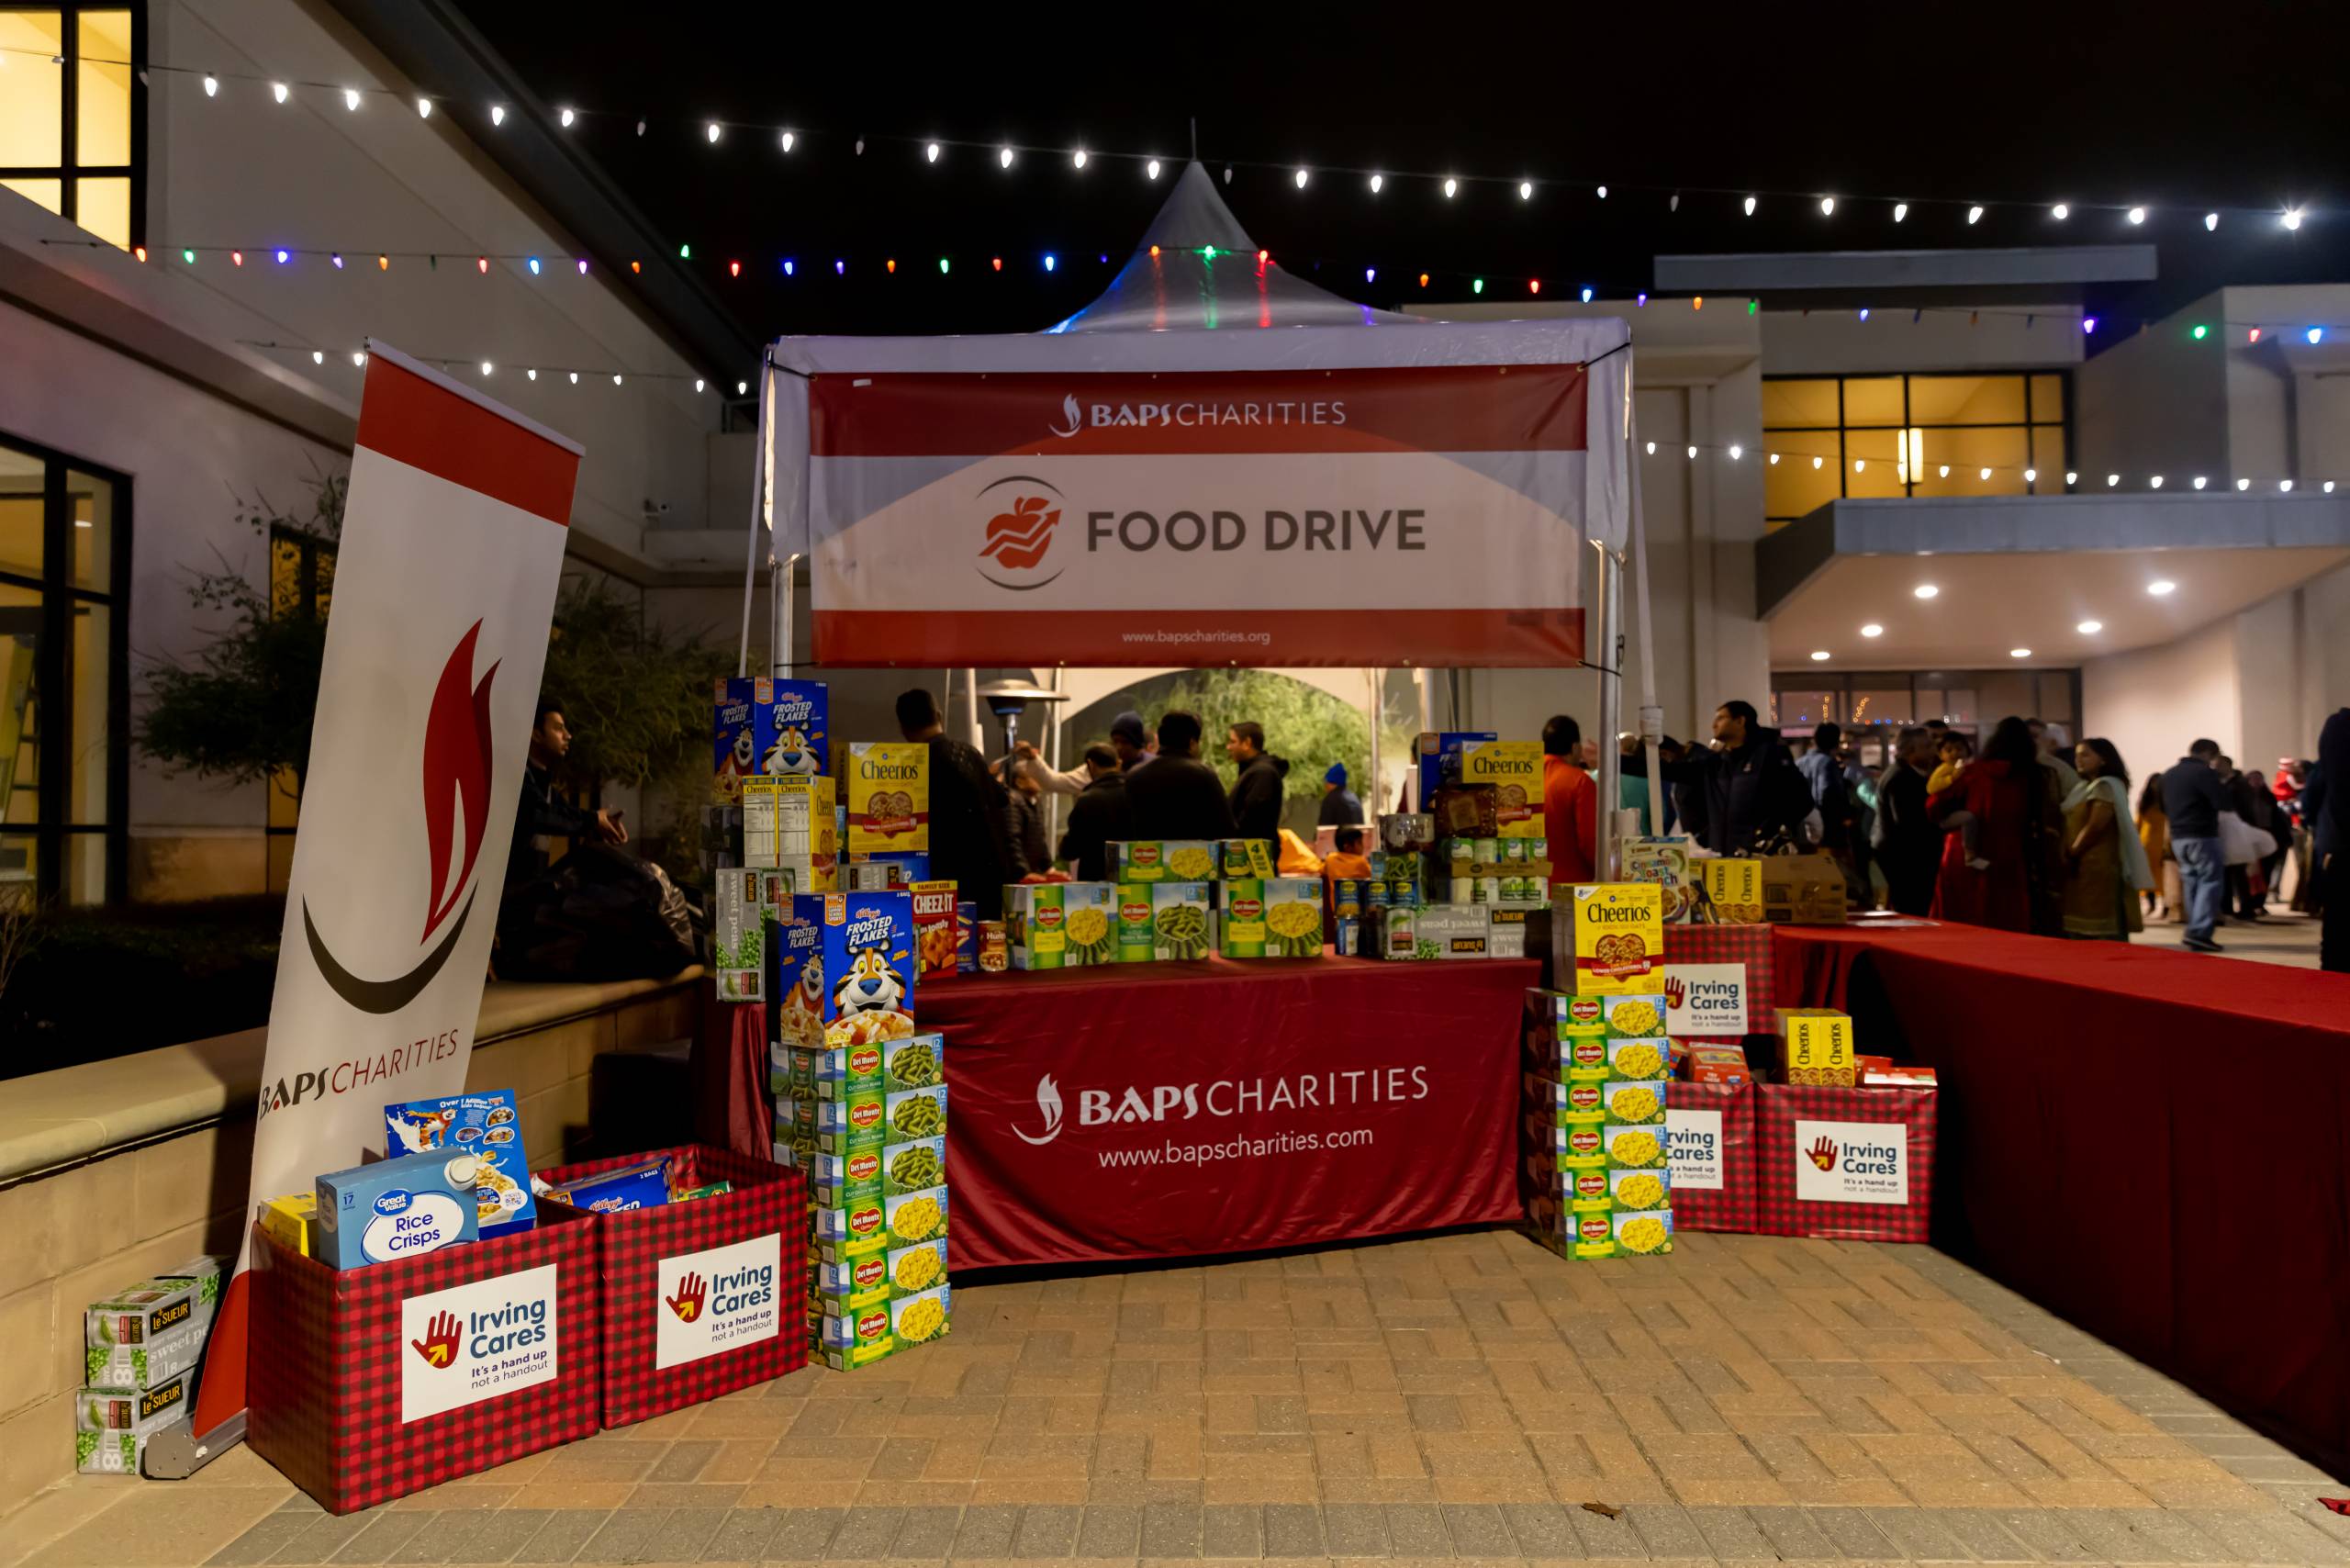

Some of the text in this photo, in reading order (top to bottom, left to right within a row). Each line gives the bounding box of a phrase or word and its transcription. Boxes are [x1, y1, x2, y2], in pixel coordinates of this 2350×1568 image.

[1087, 509, 1427, 553] FOOD DRIVE
[1121, 629, 1271, 645] www.bapscharities.org
[722, 703, 749, 717] FROSTED
[773, 700, 812, 715] FROSTED
[722, 712, 746, 725] FLAKES
[775, 711, 810, 723] FLAKES
[860, 759, 919, 780] Cheerios
[1472, 756, 1534, 774] Cheerios
[746, 785, 772, 793] Cheerios
[781, 785, 807, 793] Cheerios
[1714, 865, 1726, 902] Cheerios
[1740, 866, 1752, 902] Cheerios
[1587, 902, 1651, 924] Cheerios
[788, 925, 818, 940] FROSTED
[845, 915, 893, 936] FROSTED
[789, 935, 816, 949] FLAKES
[849, 927, 890, 946] FLAKES
[1689, 980, 1739, 998] Irving
[1690, 996, 1740, 1010] Cares
[933, 1038, 941, 1047] 12
[1798, 1023, 1811, 1065] Cheerios
[1830, 1023, 1842, 1065] Cheerios
[852, 1054, 878, 1067] Del Monte
[938, 1090, 946, 1098] 12
[440, 1100, 460, 1108] Over
[853, 1107, 880, 1119] Del Monte
[935, 1140, 944, 1148] 12
[1666, 1128, 1715, 1148] rving
[1098, 1126, 1374, 1169] www.bapscharities.com
[1842, 1142, 1897, 1163] Irving
[643, 1170, 658, 1178] BAGS
[850, 1160, 878, 1173] Del Monte
[1842, 1159, 1897, 1175] Cares
[343, 1194, 353, 1205] 17
[377, 1193, 407, 1207] Great
[938, 1190, 946, 1198] 12
[385, 1202, 408, 1212] Value
[588, 1196, 623, 1212] Kellogg's
[396, 1214, 433, 1232] Rice
[853, 1213, 880, 1226] Del Monte
[388, 1227, 441, 1251] Crisps
[938, 1239, 946, 1248] 12
[712, 1264, 772, 1294] Irving
[856, 1266, 883, 1279] Del Monte
[942, 1288, 949, 1297] 12
[711, 1286, 772, 1316] Cares
[153, 1303, 189, 1330] Le SUEUR
[470, 1299, 546, 1335] Irving
[712, 1322, 725, 1332] It's
[735, 1312, 757, 1327] hand
[760, 1310, 771, 1320] up
[859, 1317, 886, 1331] Del Monte
[711, 1331, 727, 1342] not
[736, 1319, 772, 1335] handout
[150, 1326, 209, 1364] sweet pe
[470, 1324, 546, 1359] Cares
[170, 1362, 178, 1372] 8
[472, 1350, 547, 1378] It's a hand up
[113, 1368, 133, 1385] 8
[471, 1377, 489, 1389] not
[503, 1361, 548, 1381] handout
[143, 1385, 181, 1416] Le SUEUR
[102, 1452, 121, 1470] 8
